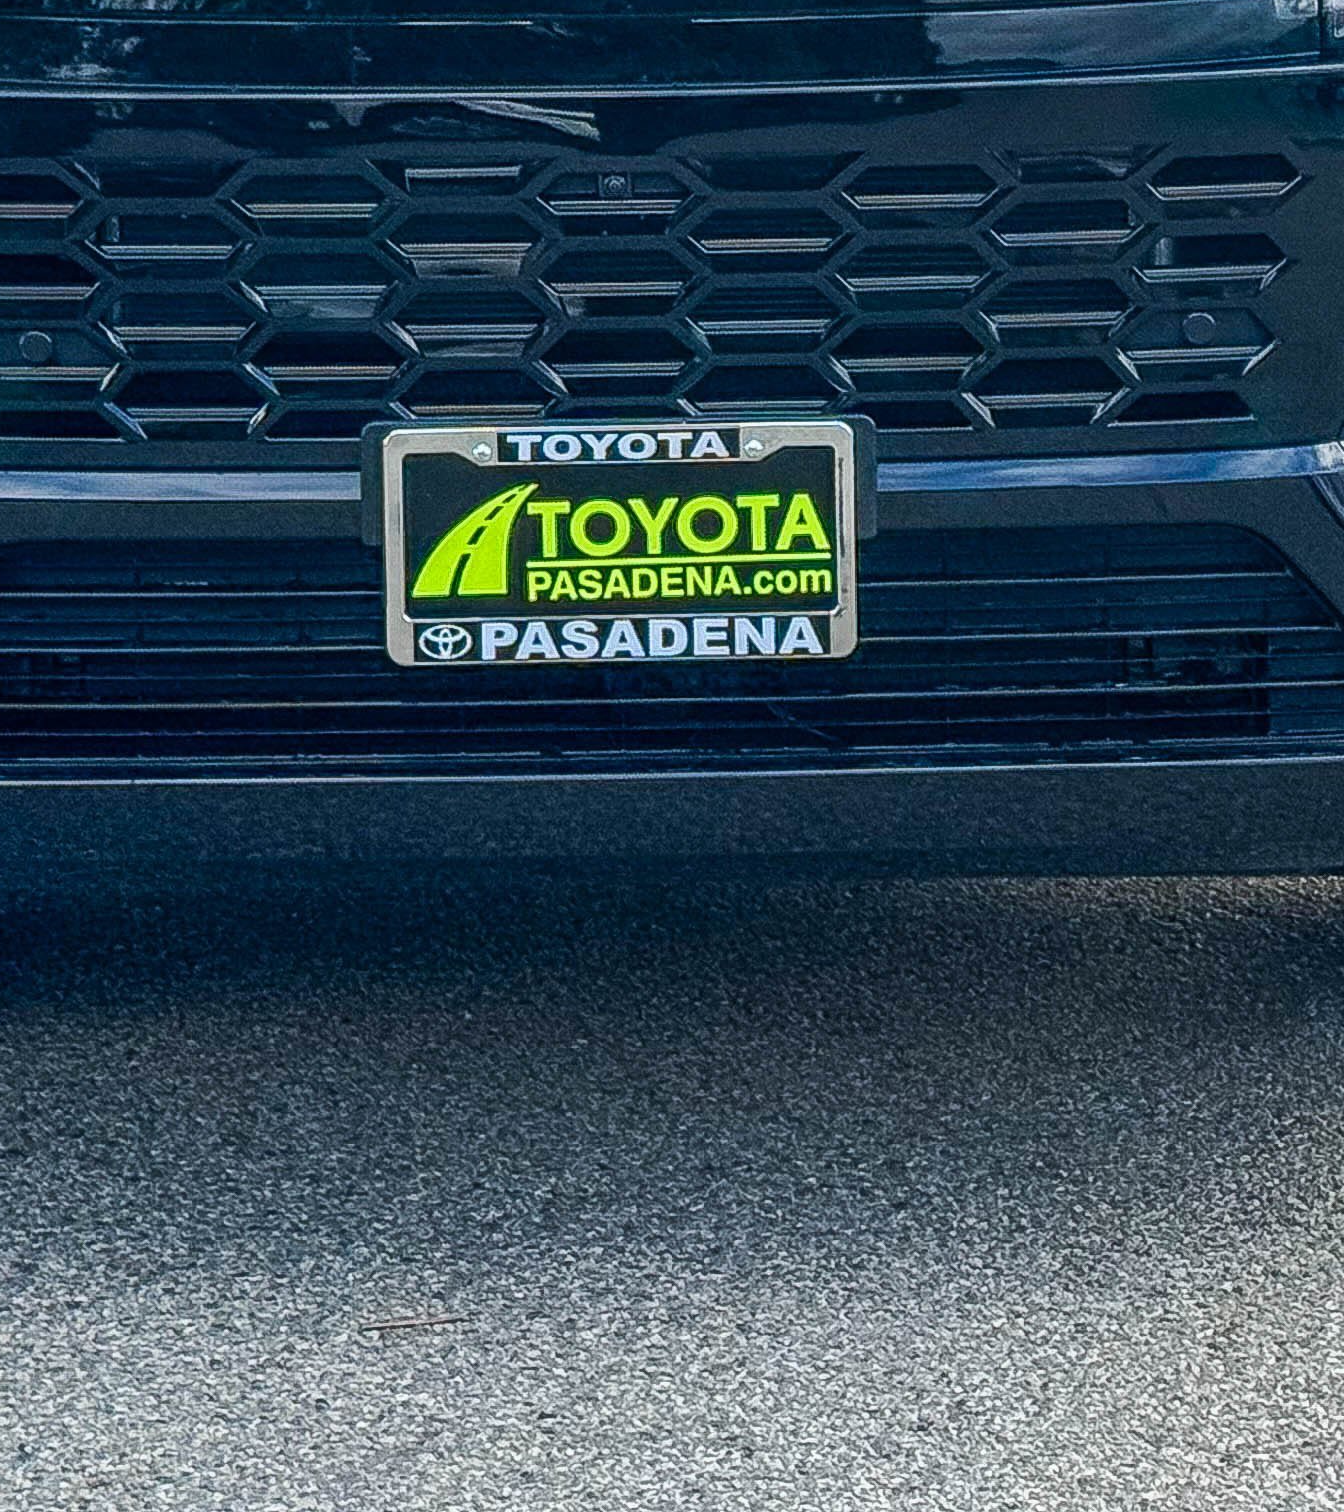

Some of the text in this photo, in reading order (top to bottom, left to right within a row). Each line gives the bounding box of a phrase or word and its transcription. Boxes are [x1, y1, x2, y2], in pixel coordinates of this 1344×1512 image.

[506, 432, 730, 462] TOYOTA
[527, 493, 831, 558] TOYOTA
[528, 565, 832, 602] PASADENA.com
[481, 616, 824, 660] PASADENA
